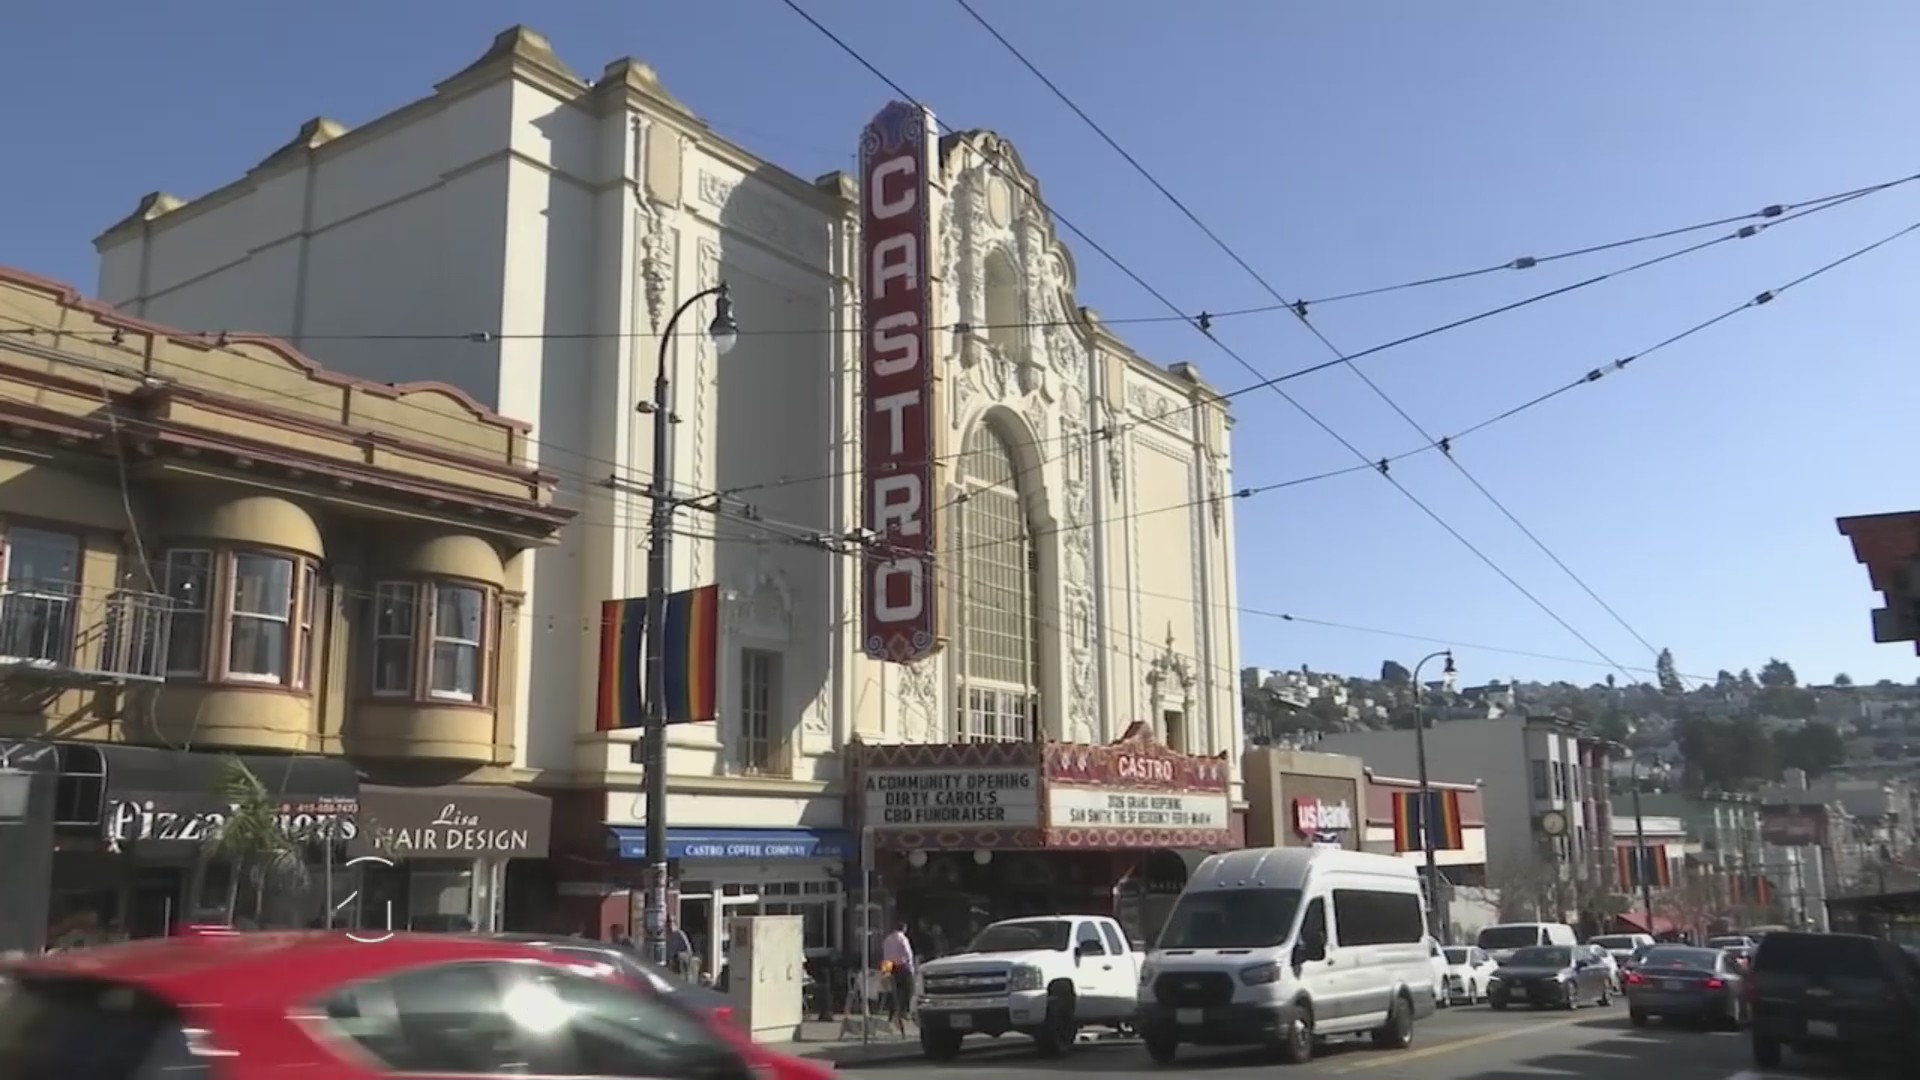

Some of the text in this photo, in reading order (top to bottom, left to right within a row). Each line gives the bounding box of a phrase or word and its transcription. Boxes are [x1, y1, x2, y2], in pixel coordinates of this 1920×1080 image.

[870, 155, 922, 624] CASTRO
[1119, 756, 1172, 781] CASTRO
[866, 773, 1030, 790] A COMMUNITY OPENING
[885, 790, 998, 805] DIRTY CAROL'S
[432, 804, 479, 826] Lisa
[884, 807, 1005, 823] CBD FUNDRAISER
[446, 828, 529, 851] DESIGN
[685, 844, 724, 857] CASTRO
[727, 844, 761, 857] COFFEE
